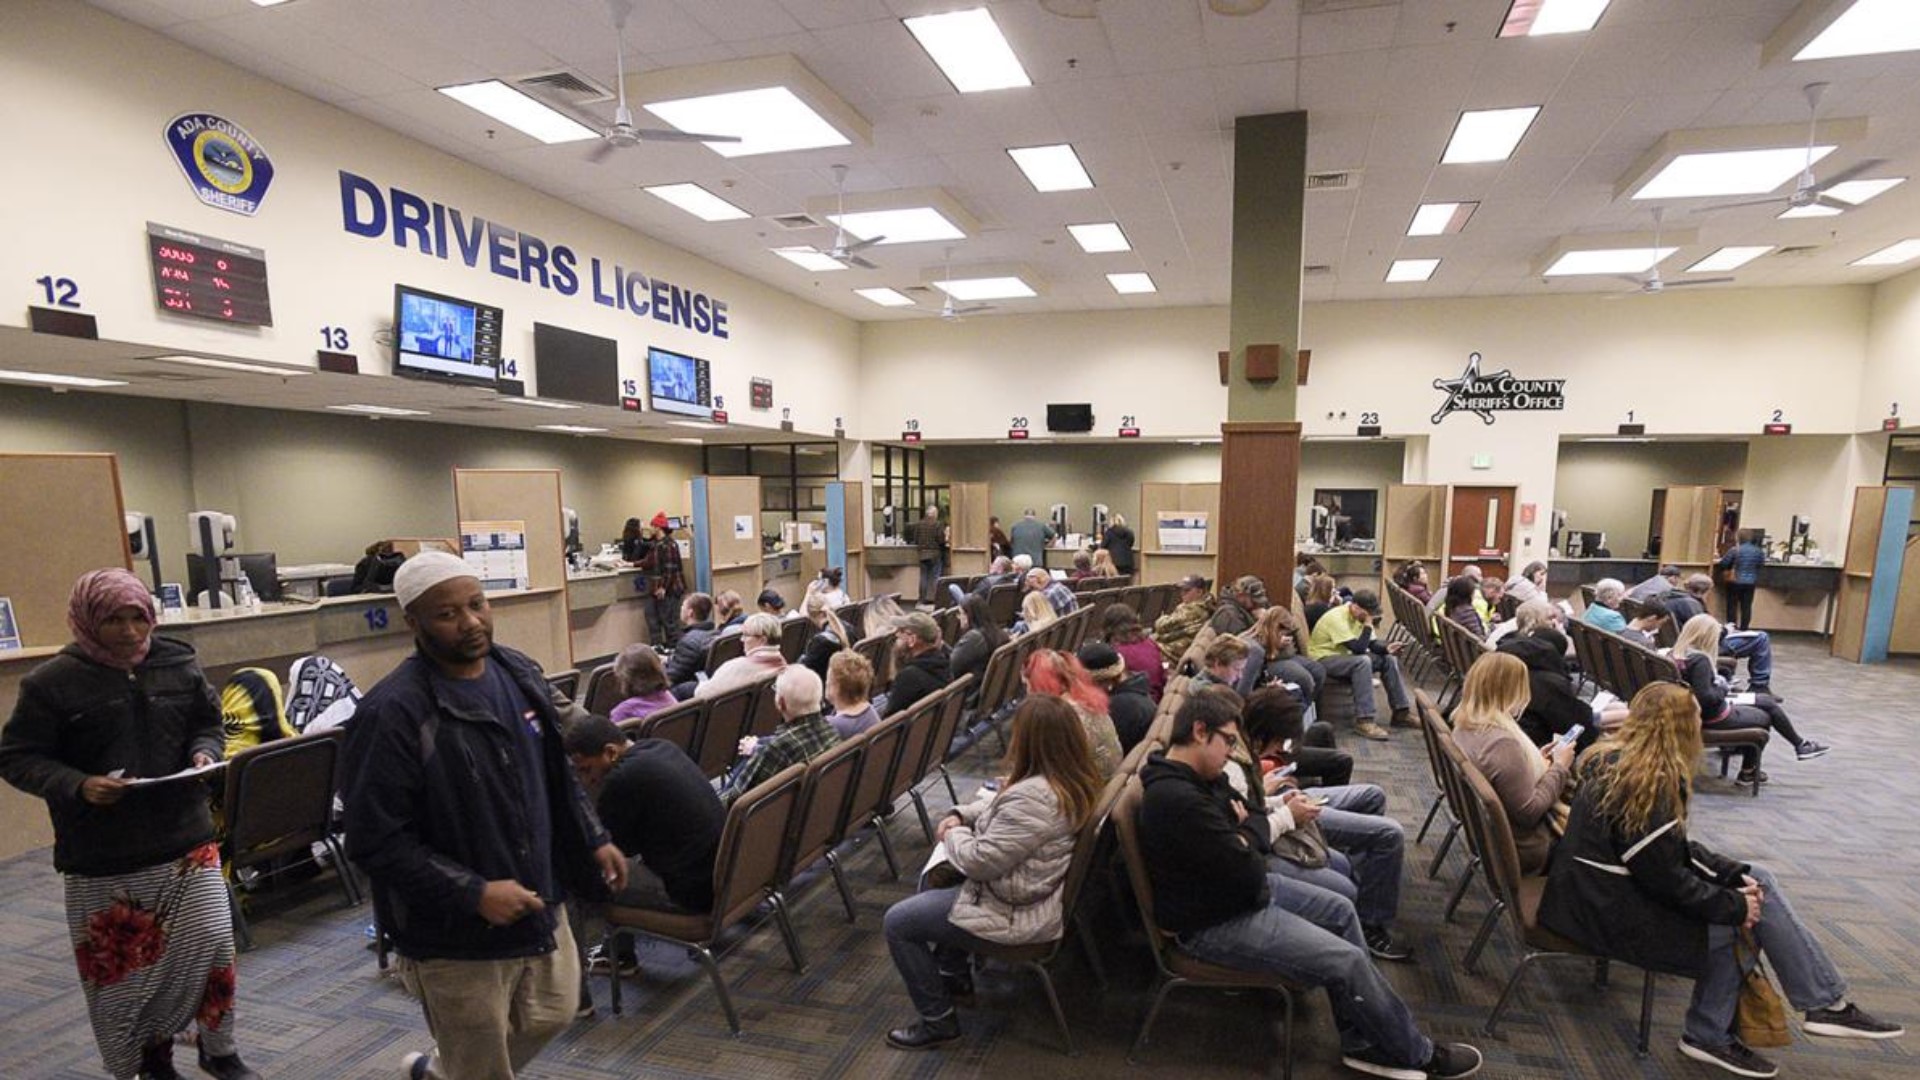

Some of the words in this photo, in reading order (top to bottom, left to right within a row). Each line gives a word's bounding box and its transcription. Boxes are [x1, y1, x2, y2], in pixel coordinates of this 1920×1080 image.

[177, 117, 205, 140] ADA
[206, 117, 264, 160] COUNTY
[200, 187, 256, 213] SHERIFF
[338, 170, 579, 296] DRIVERS
[592, 257, 729, 339] LICENSE
[36, 275, 81, 308] 12
[320, 326, 349, 351] 13
[499, 358, 517, 378] 14
[623, 379, 636, 396] 15
[1461, 378, 1494, 394] ADA
[1498, 377, 1564, 394] COUNTY
[1513, 393, 1563, 409] OFFICE
[1012, 417, 1028, 428] 20
[1122, 416, 1136, 427] 21
[1361, 412, 1379, 425] 23
[1627, 410, 1634, 422] 1
[1772, 409, 1783, 422] 2
[905, 420, 919, 431] 19
[363, 607, 388, 632] 13
